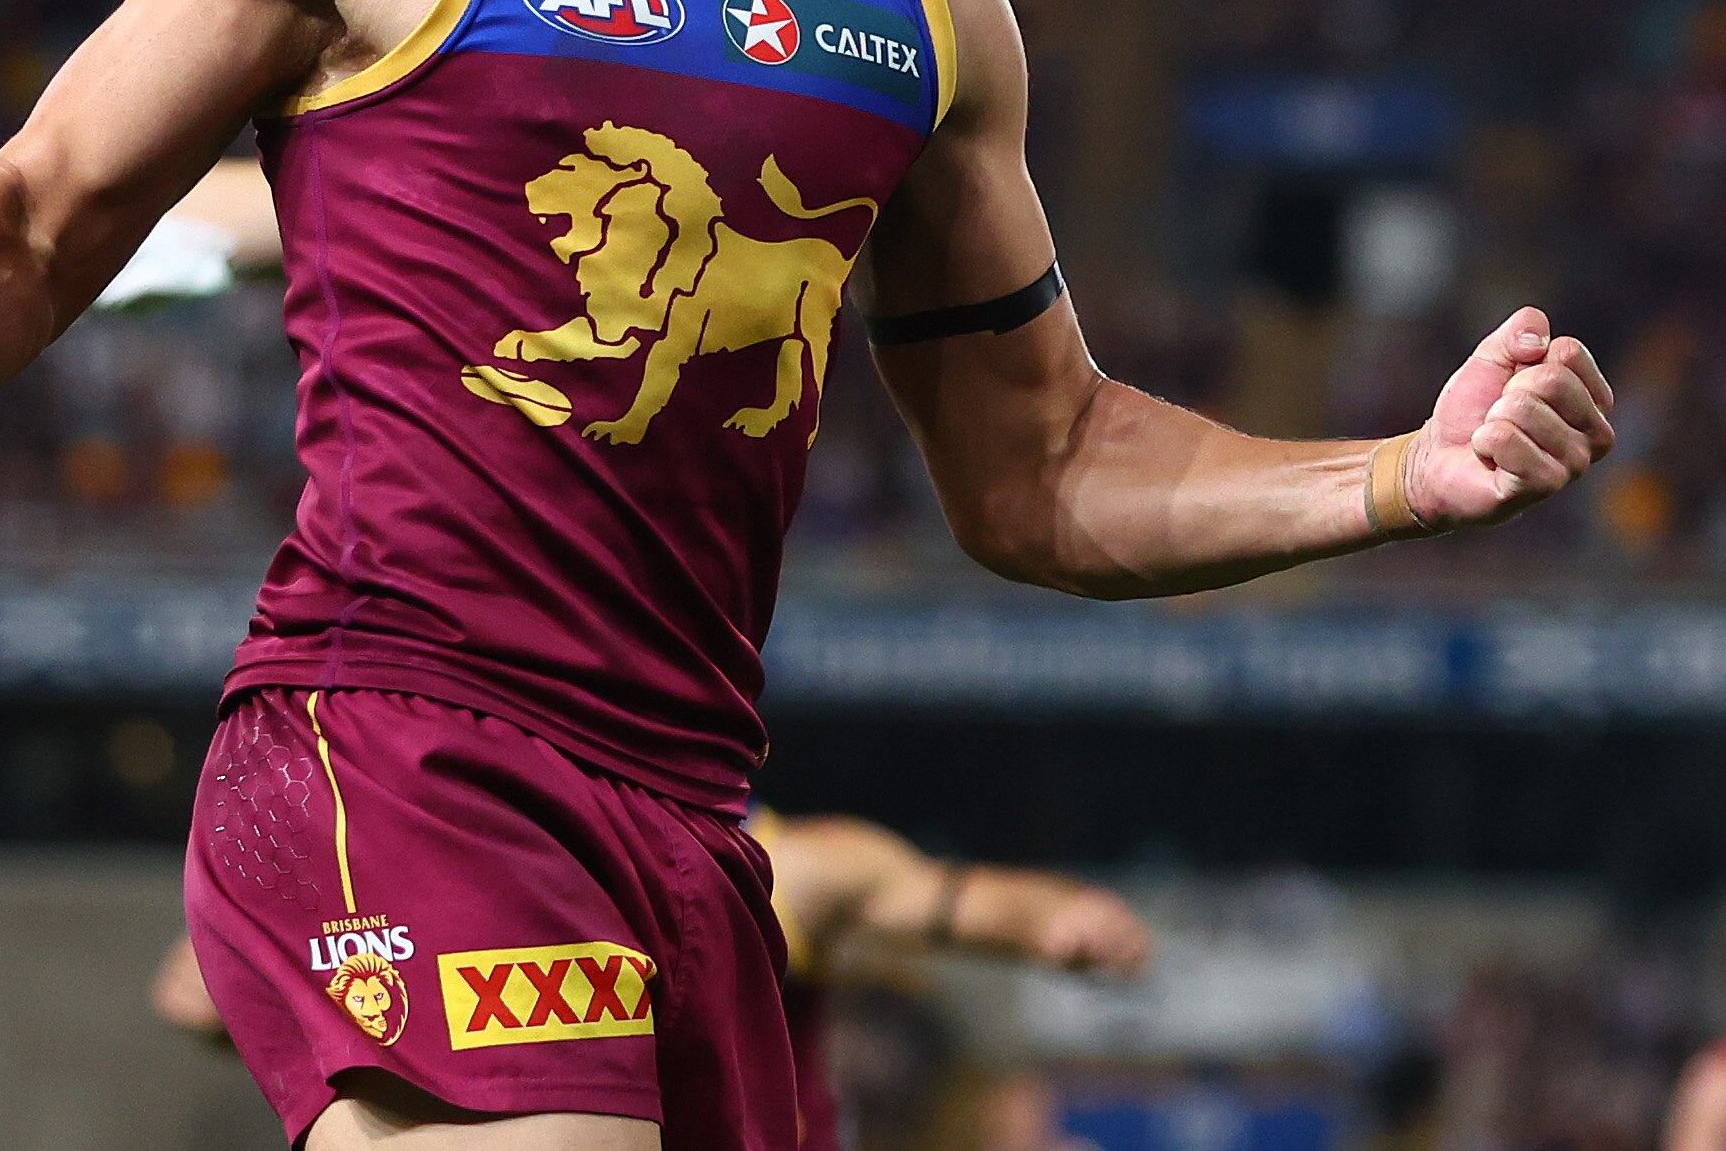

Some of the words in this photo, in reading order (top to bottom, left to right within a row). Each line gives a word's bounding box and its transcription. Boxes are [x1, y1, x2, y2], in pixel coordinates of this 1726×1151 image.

[815, 24, 919, 78] CALTEX
[323, 914, 388, 934] BRISBANE
[309, 926, 414, 970] LIONS
